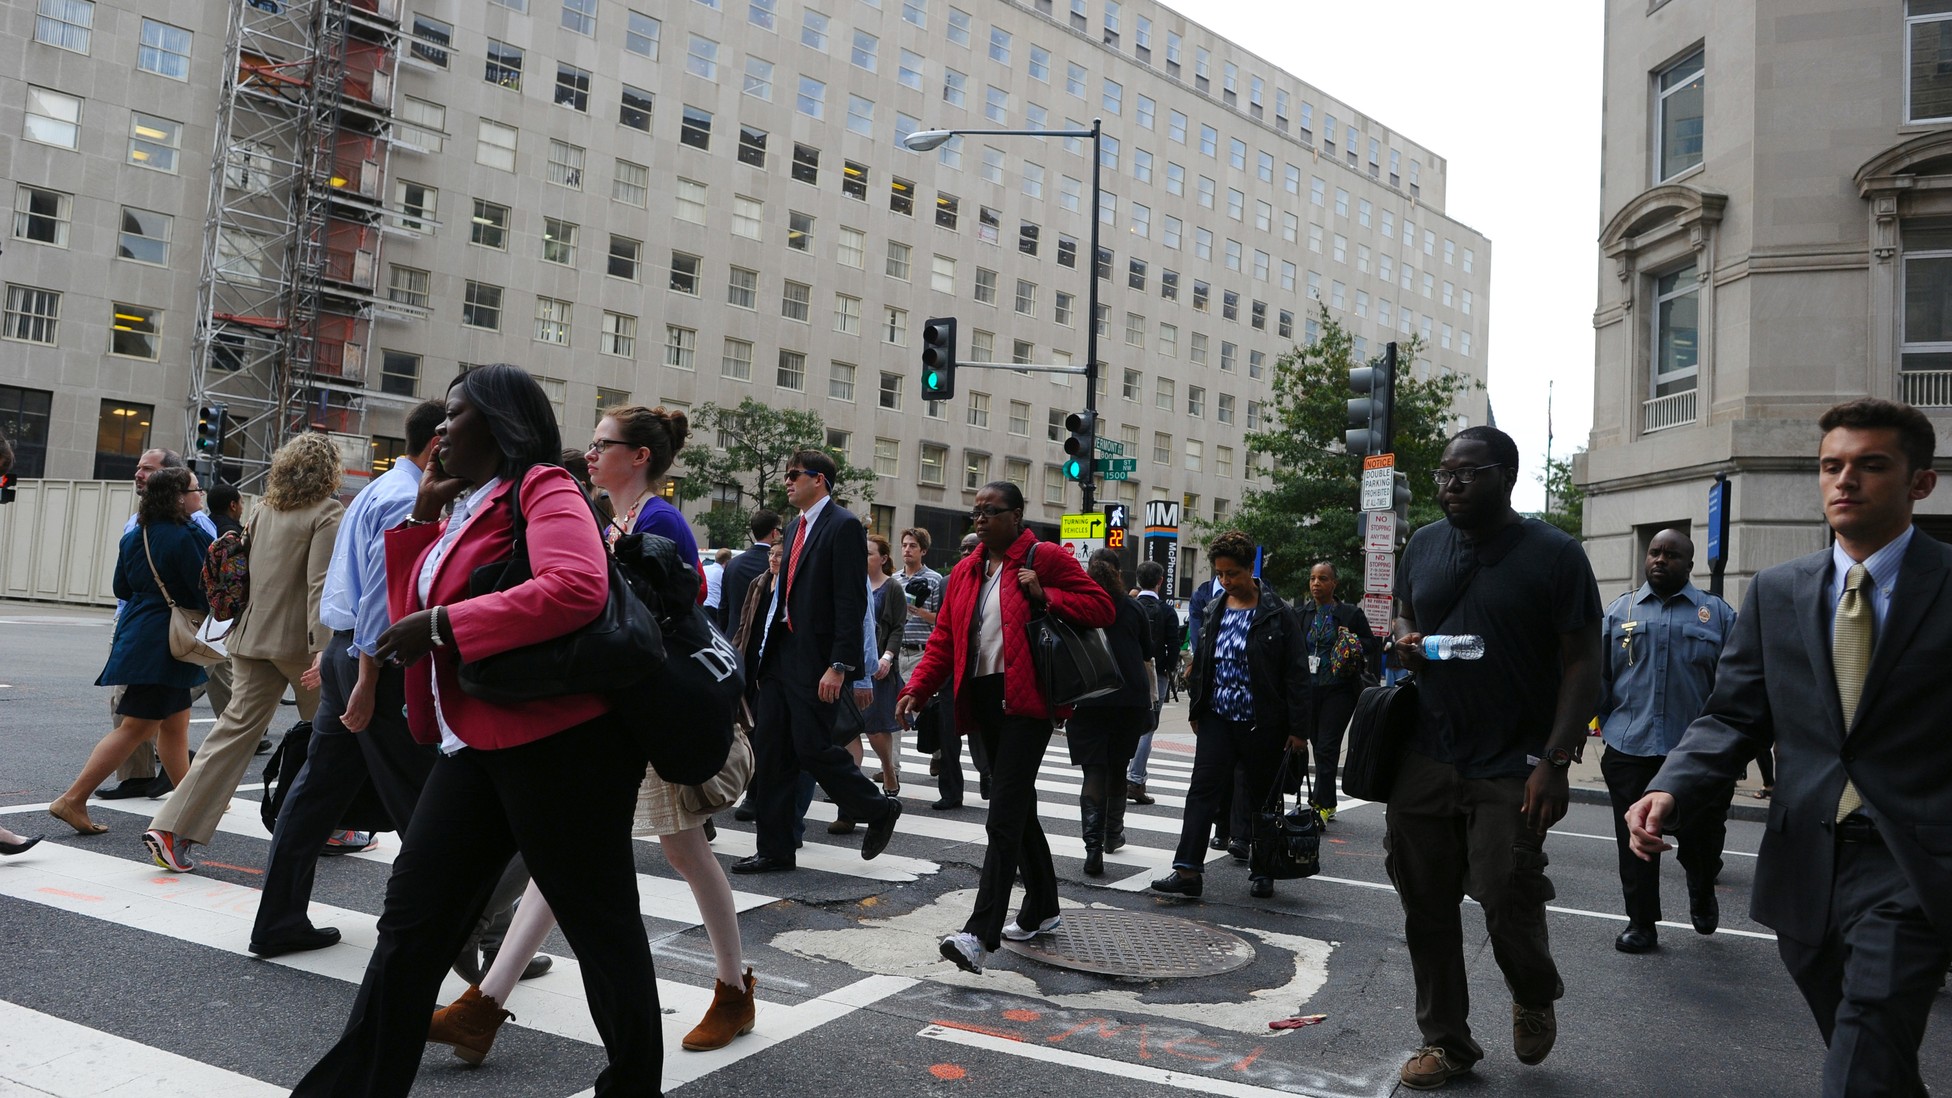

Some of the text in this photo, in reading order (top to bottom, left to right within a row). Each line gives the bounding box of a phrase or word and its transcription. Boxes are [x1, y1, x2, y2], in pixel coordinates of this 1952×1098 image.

[1366, 457, 1392, 468] NOTICE
[1105, 472, 1126, 480] 1500
[1366, 468, 1390, 479] DOUBLE
[1365, 478, 1390, 488] PARKING
[1364, 487, 1390, 497] PROHIBITED
[1156, 502, 1178, 527] M
[1109, 529, 1123, 547] 22
[1166, 542, 1177, 595] McPherson
